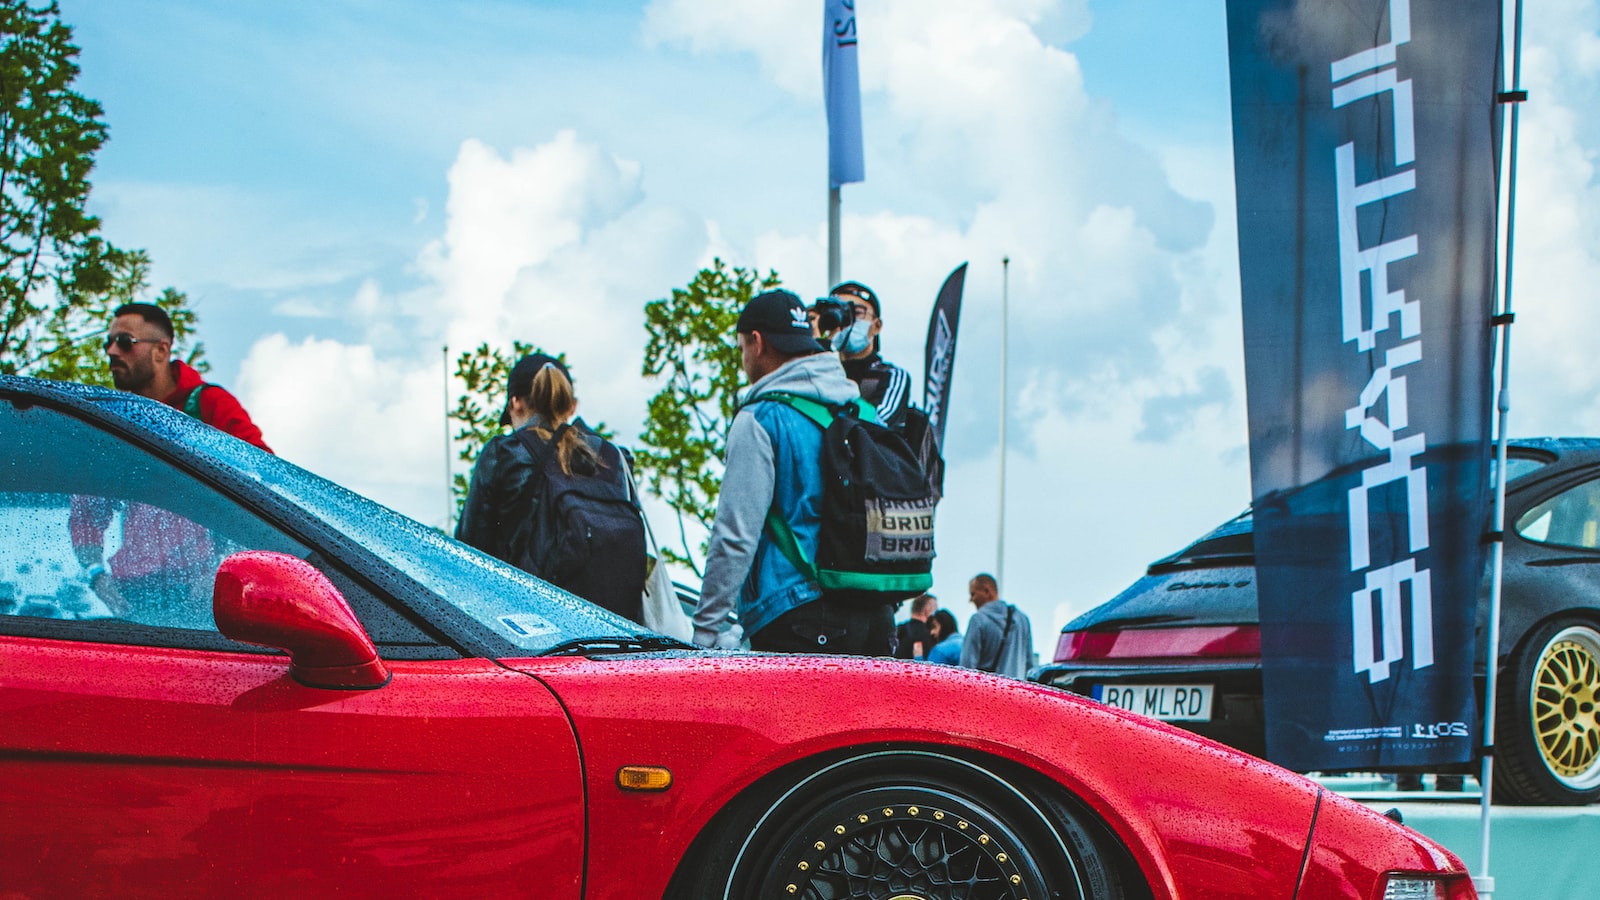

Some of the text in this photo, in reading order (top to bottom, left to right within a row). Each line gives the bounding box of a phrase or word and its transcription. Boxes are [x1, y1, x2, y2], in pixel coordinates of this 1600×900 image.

[881, 515, 934, 531] BRID
[881, 536, 934, 553] BRID
[1143, 688, 1202, 716] MLRD
